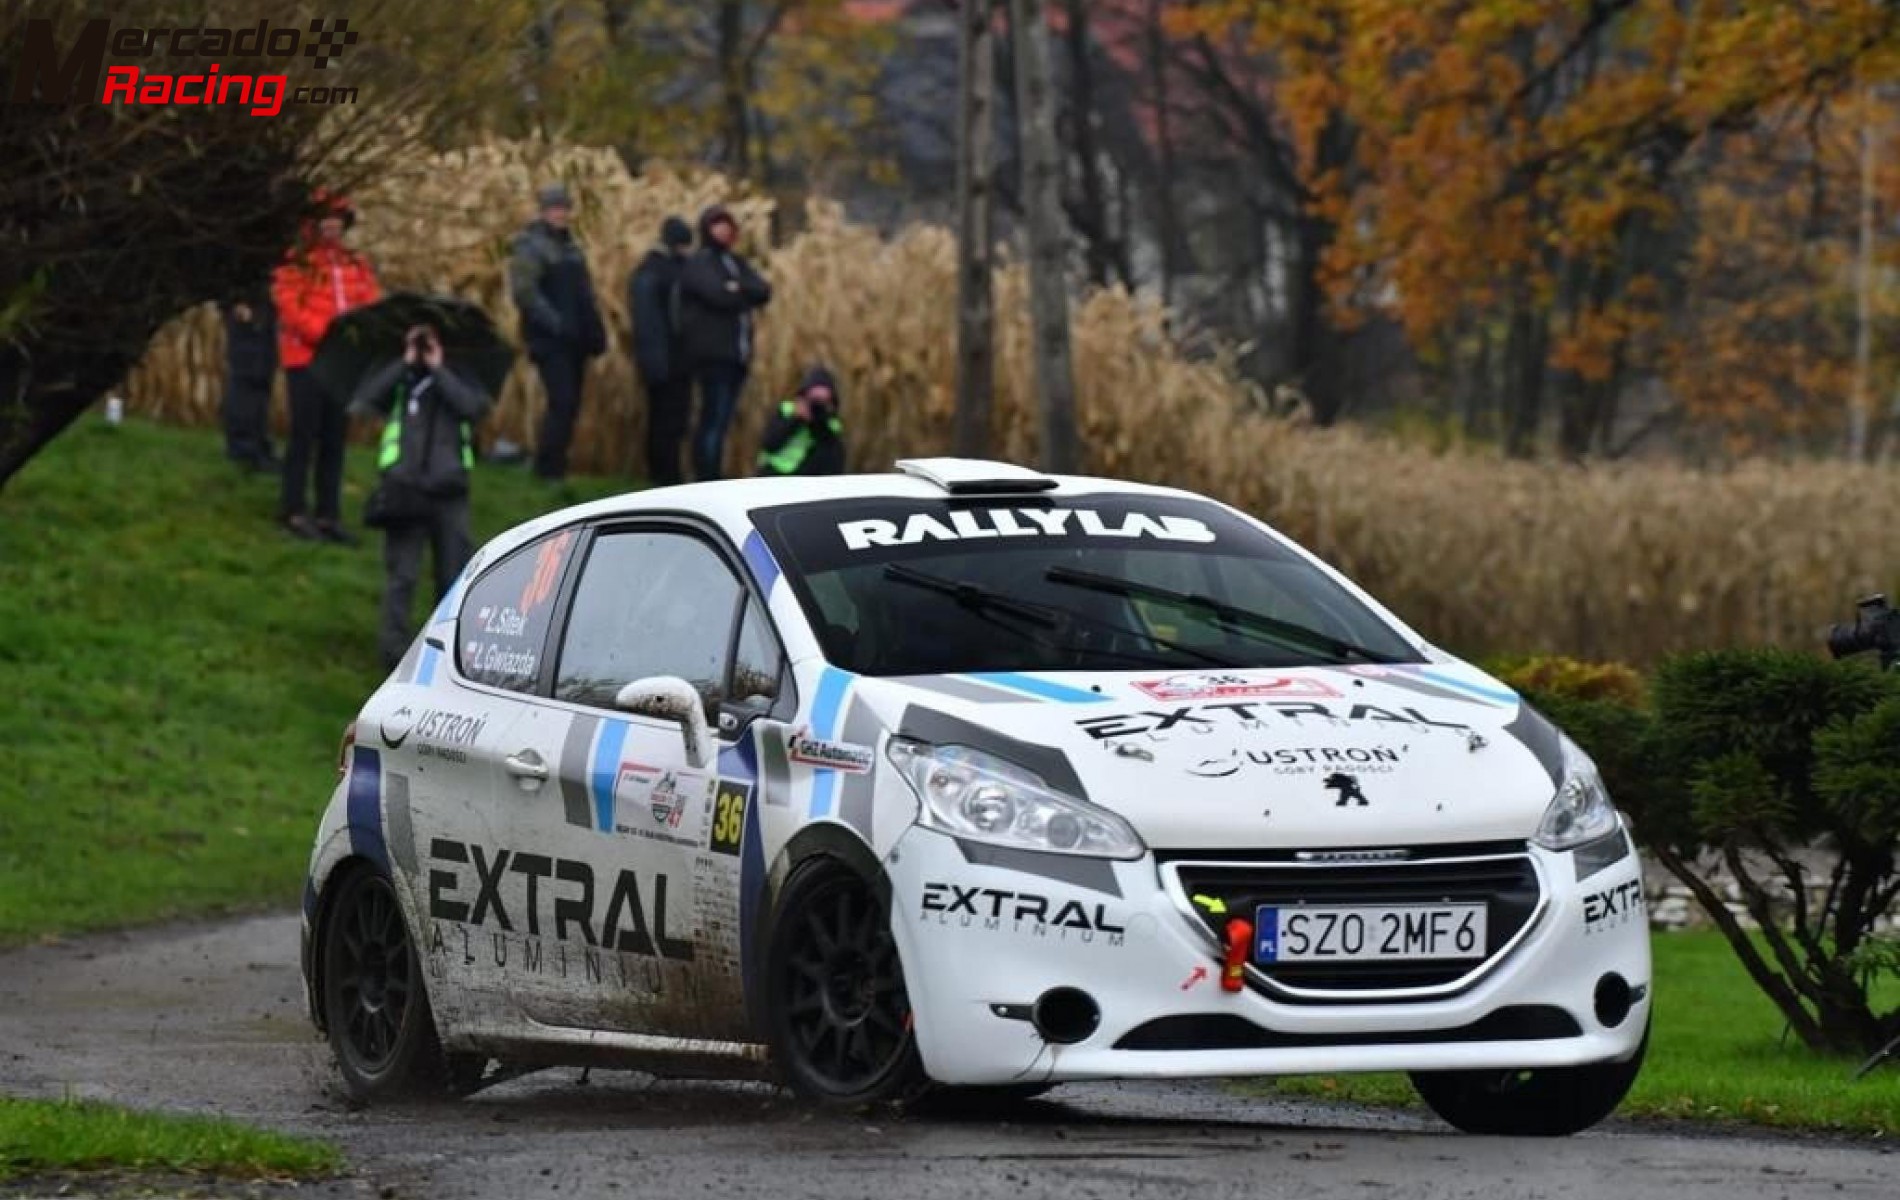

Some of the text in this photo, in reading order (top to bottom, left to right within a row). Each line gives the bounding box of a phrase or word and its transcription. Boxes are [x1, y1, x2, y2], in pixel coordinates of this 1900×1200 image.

[837, 508, 1217, 550] RALLYLAB
[1075, 701, 1473, 740] EXTRAL
[1246, 745, 1399, 764] USTROŃ
[714, 793, 745, 845] 36
[429, 837, 696, 962] EXTRAL
[921, 882, 1125, 933] EXTRAL
[919, 912, 1125, 947] ALUMINIUM
[1380, 910, 1476, 955] 2MF6
